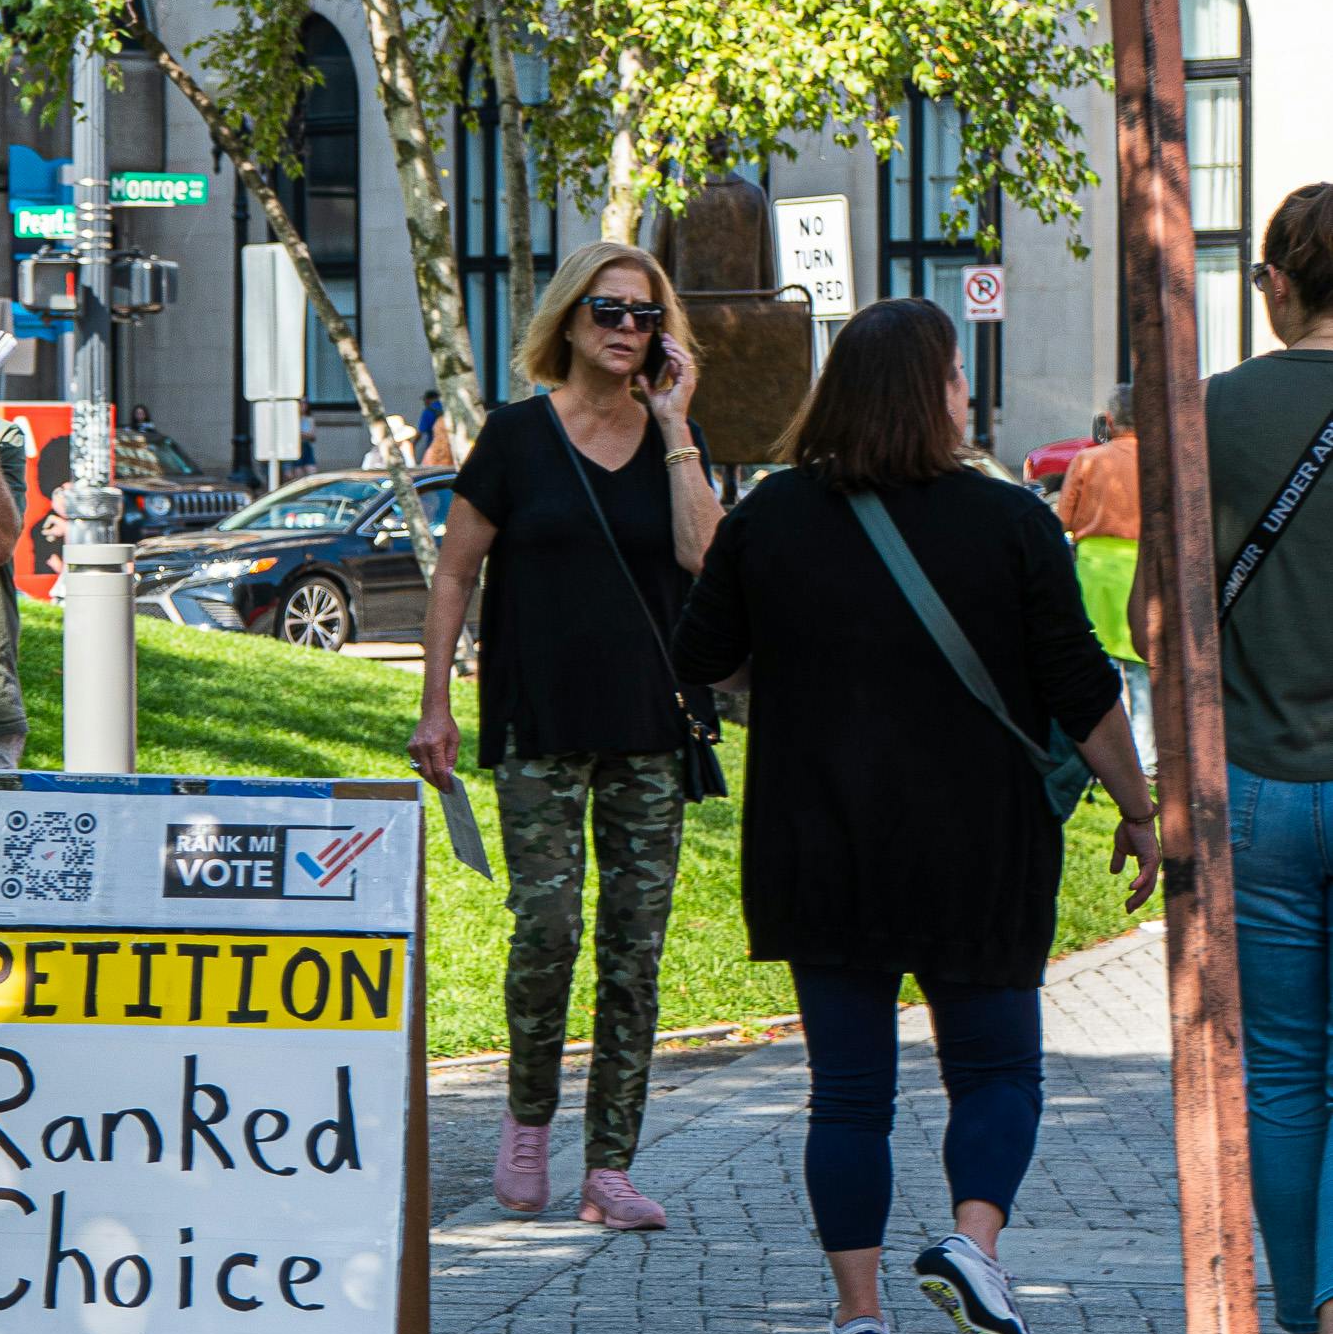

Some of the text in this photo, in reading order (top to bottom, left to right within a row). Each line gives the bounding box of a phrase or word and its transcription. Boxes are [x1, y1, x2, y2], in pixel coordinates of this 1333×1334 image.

[111, 177, 188, 200] Monroe
[19, 208, 65, 235] Pearl
[798, 216, 825, 237] NO
[794, 249, 834, 270] TURN
[815, 280, 844, 301] RED
[1262, 421, 1333, 534] UNDER AR
[176, 835, 276, 853] RANK MI
[176, 858, 274, 888] VOTE
